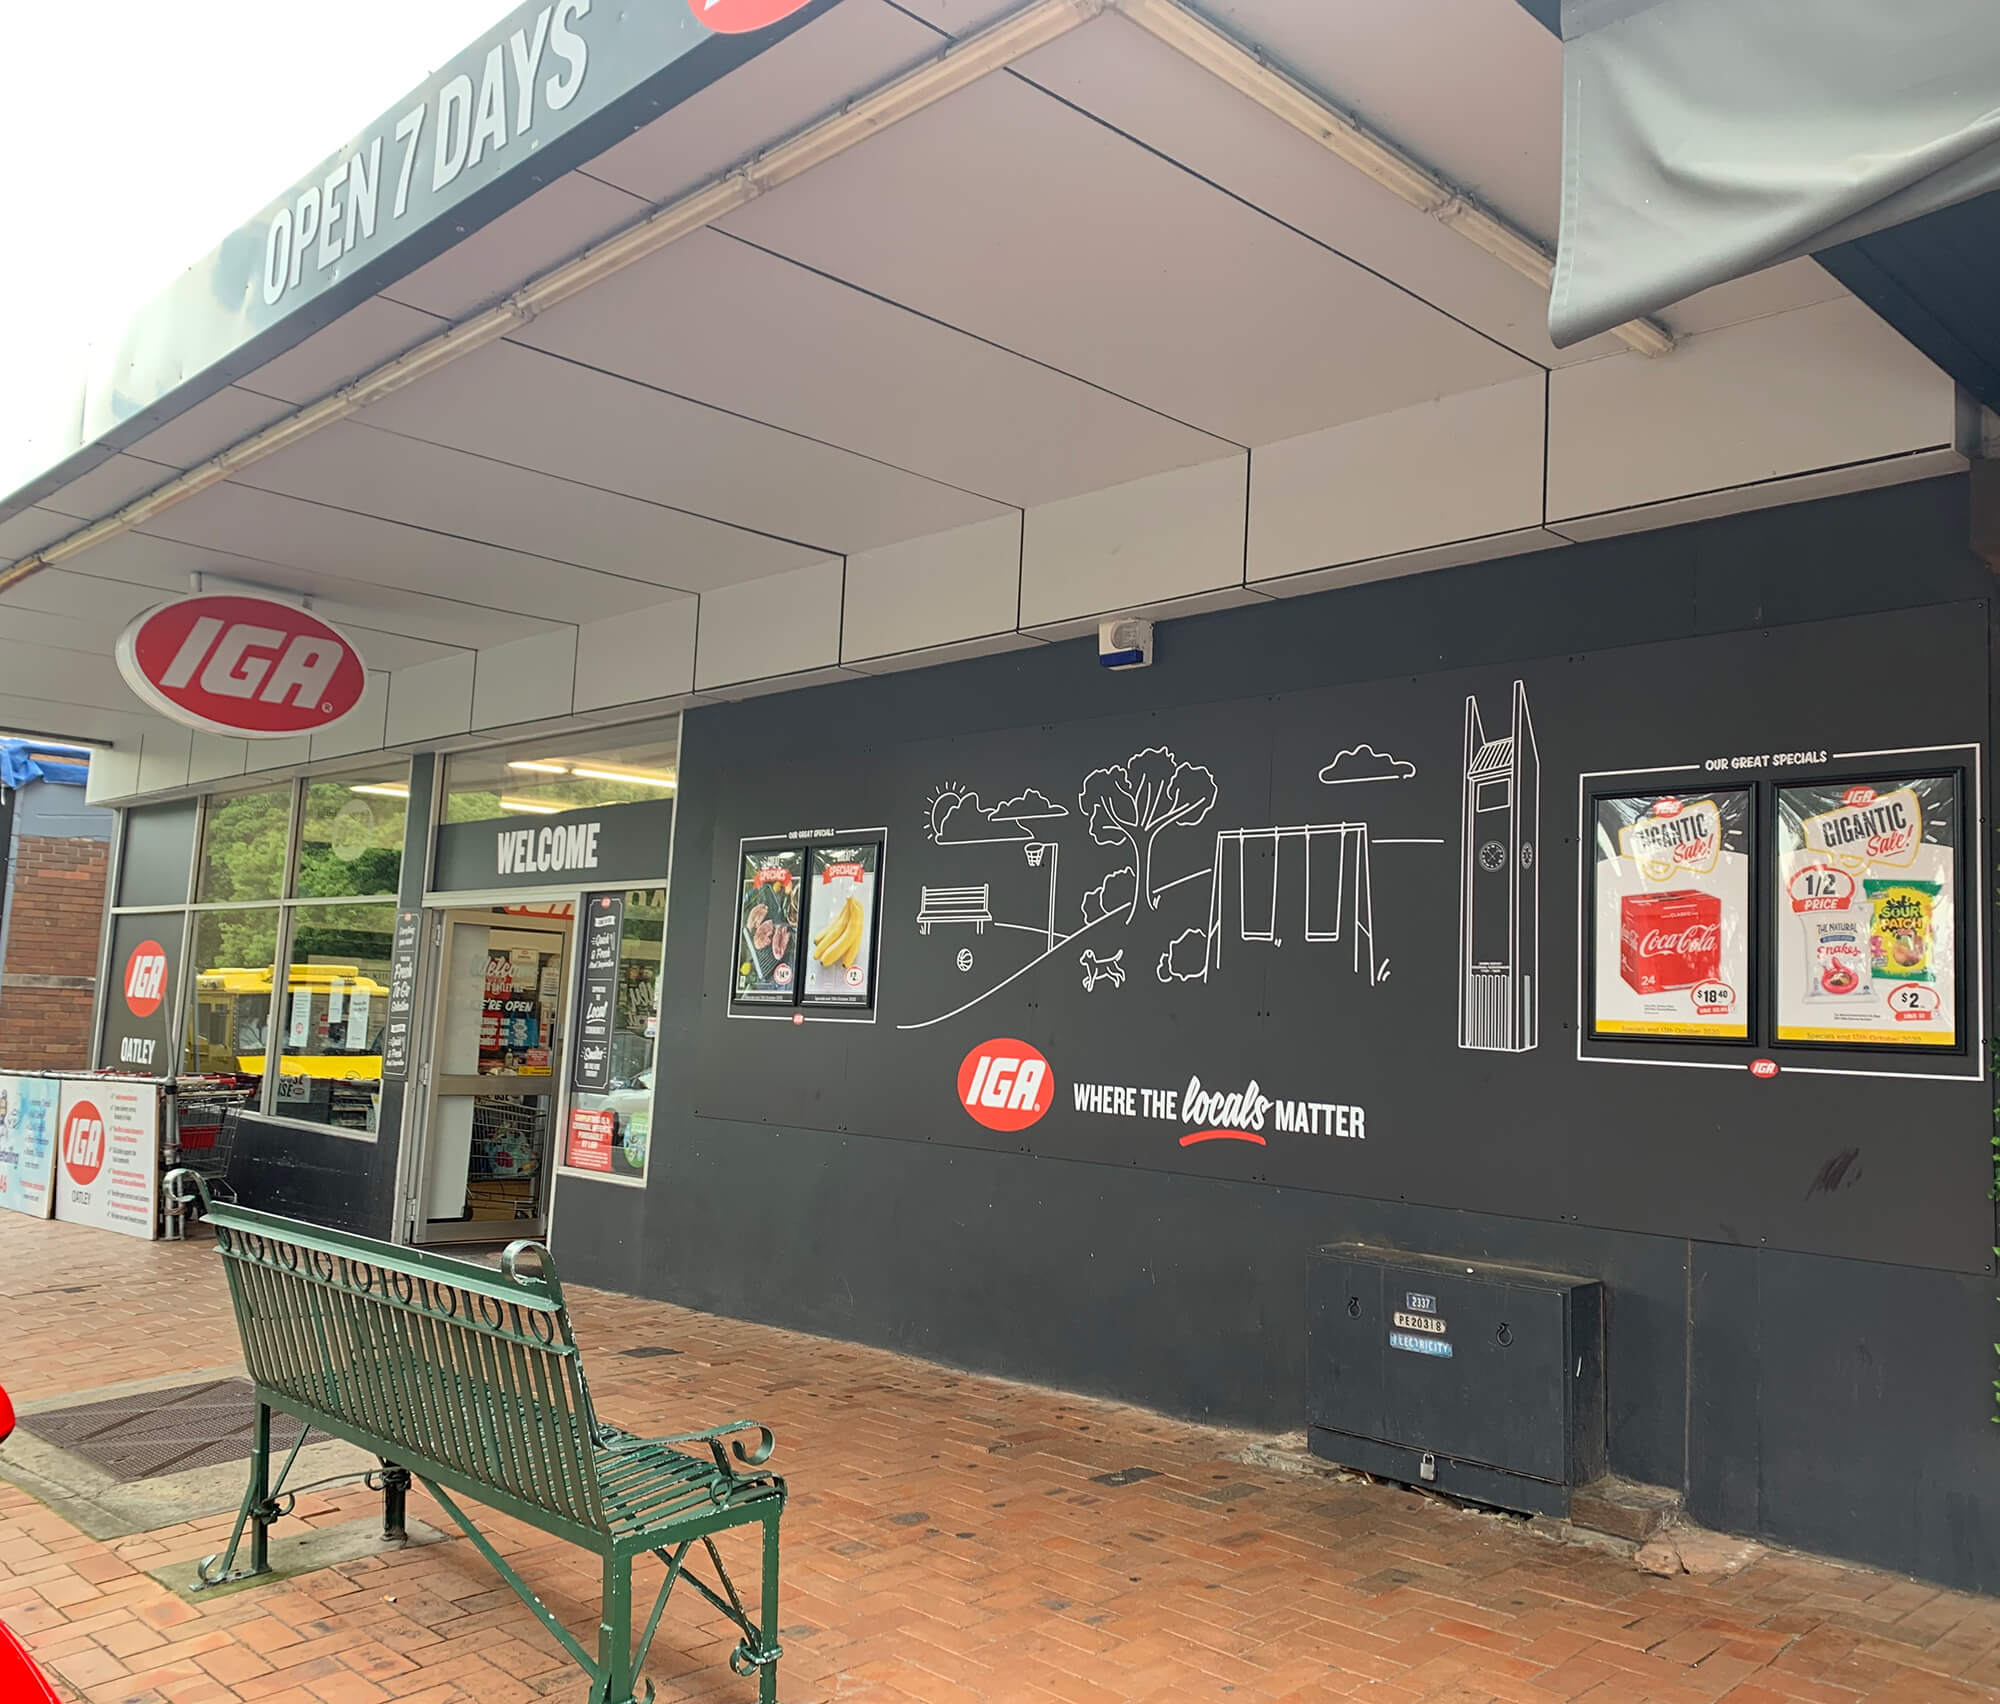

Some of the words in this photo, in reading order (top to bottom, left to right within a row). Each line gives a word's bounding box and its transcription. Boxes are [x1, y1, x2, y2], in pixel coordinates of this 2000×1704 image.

[263, 135, 384, 306] OPEN
[392, 103, 426, 219] 7
[432, 0, 593, 193] DAYS
[159, 616, 344, 710] IGA
[1705, 758, 1729, 771] OUR
[1731, 755, 1770, 769] GREAT
[1772, 750, 1828, 766] SPECIALS
[1846, 790, 1875, 804] IGA
[1640, 813, 1708, 848] IGANTIC
[1823, 803, 1907, 848] GIGANTIC
[1866, 824, 1913, 857] Sale!
[497, 822, 600, 875] WELCOME
[1673, 833, 1713, 863] Sale!
[1805, 874, 1836, 896] 1/2
[1804, 899, 1838, 910] PRICE
[1881, 905, 1919, 919] SOUR
[1881, 917, 1922, 931] PATCH
[1640, 923, 1721, 957] Coca-Cola
[127, 955, 166, 1000] IGA
[1641, 976, 1656, 986] 24
[505, 1000, 533, 1012] OPEN
[121, 1036, 156, 1065] OATLEY
[966, 1055, 1046, 1111] IGA
[1752, 1062, 1776, 1074] IGA
[1073, 1082, 1138, 1115] WHERE
[1140, 1088, 1177, 1121] THE
[1181, 1074, 1273, 1132] locals
[1275, 1100, 1366, 1140] MATTER
[66, 1118, 102, 1168] IGA
[1412, 1296, 1430, 1309] 2337
